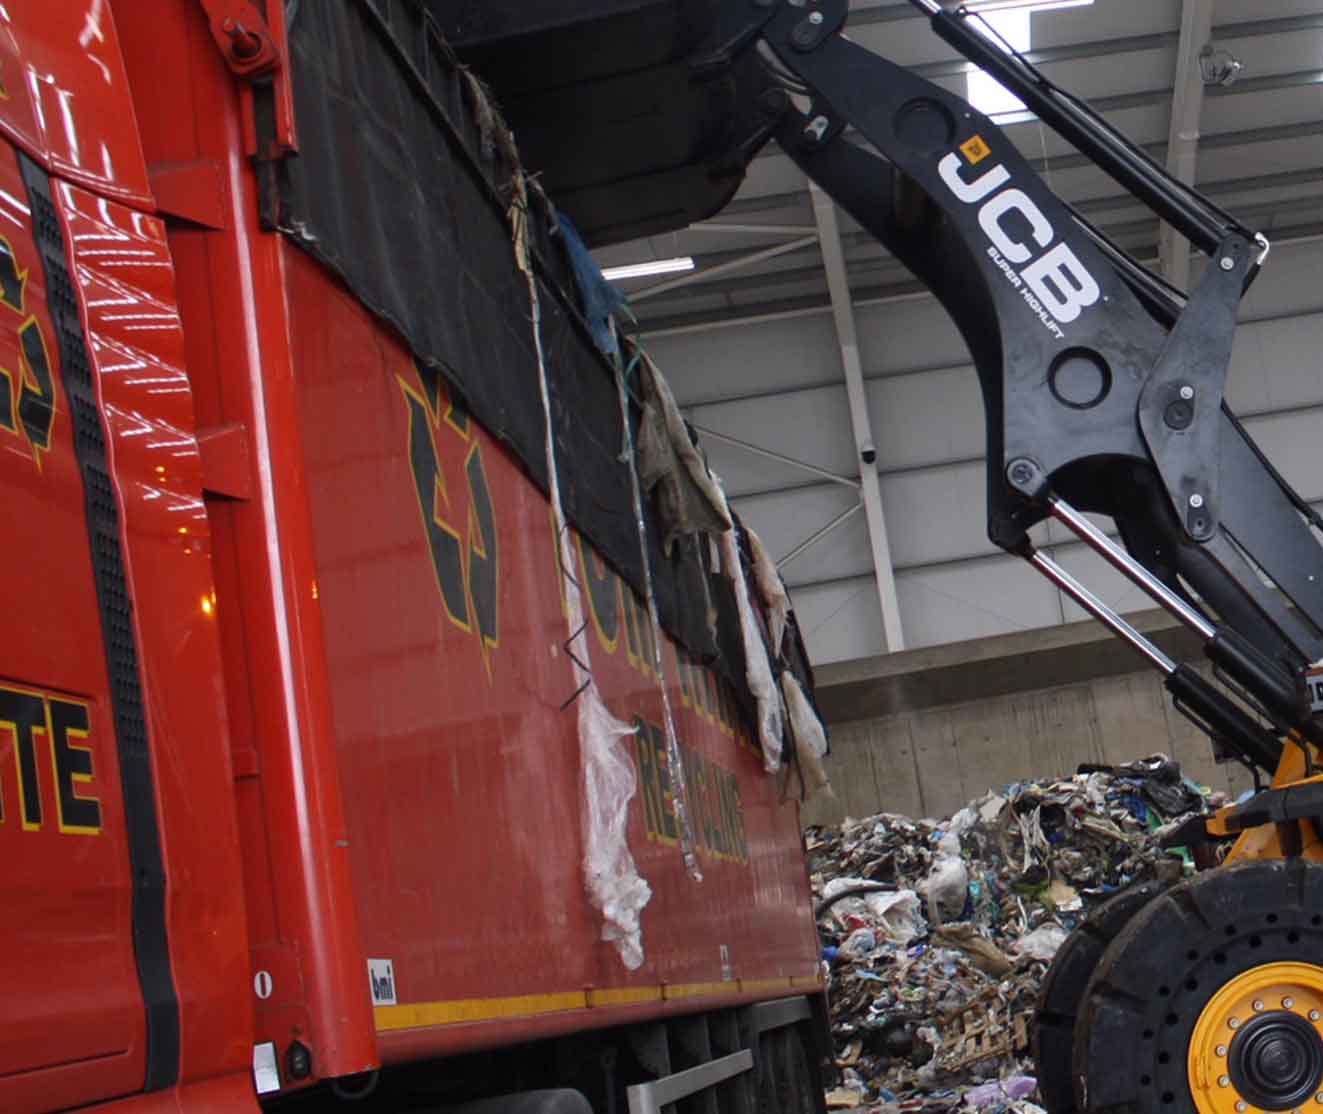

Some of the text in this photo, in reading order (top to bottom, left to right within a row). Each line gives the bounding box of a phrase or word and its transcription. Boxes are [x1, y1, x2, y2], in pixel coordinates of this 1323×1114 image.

[938, 151, 1101, 324] JCB
[986, 245, 1065, 339] SUPER HIGHLIFT
